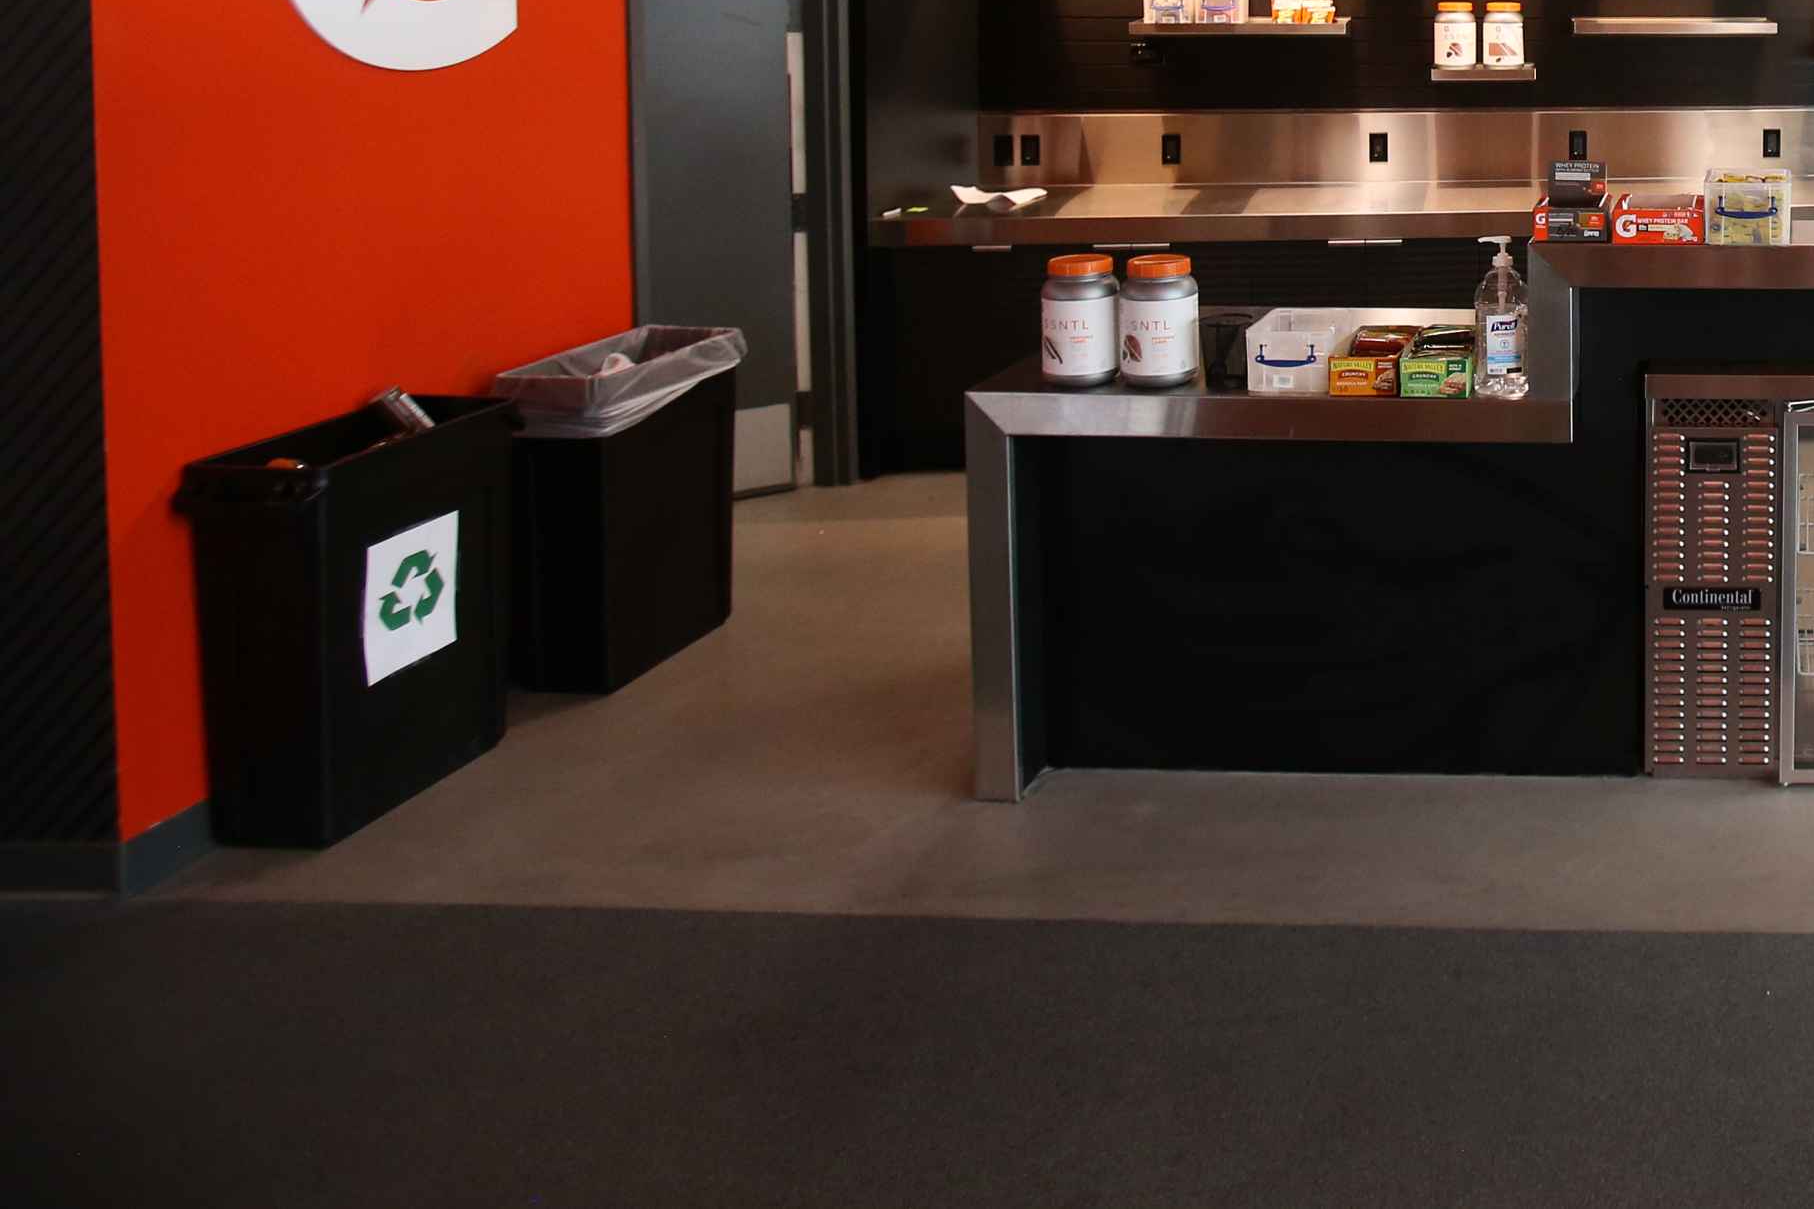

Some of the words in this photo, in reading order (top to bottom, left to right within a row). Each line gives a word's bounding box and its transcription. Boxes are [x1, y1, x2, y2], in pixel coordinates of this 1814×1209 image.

[1615, 214, 1637, 238] G
[1332, 361, 1353, 370] NATURE
[1353, 361, 1373, 370] VALLEY
[1403, 363, 1424, 371] NATURE
[1424, 364, 1443, 373] VALLEY
[1672, 589, 1752, 604] Continental
